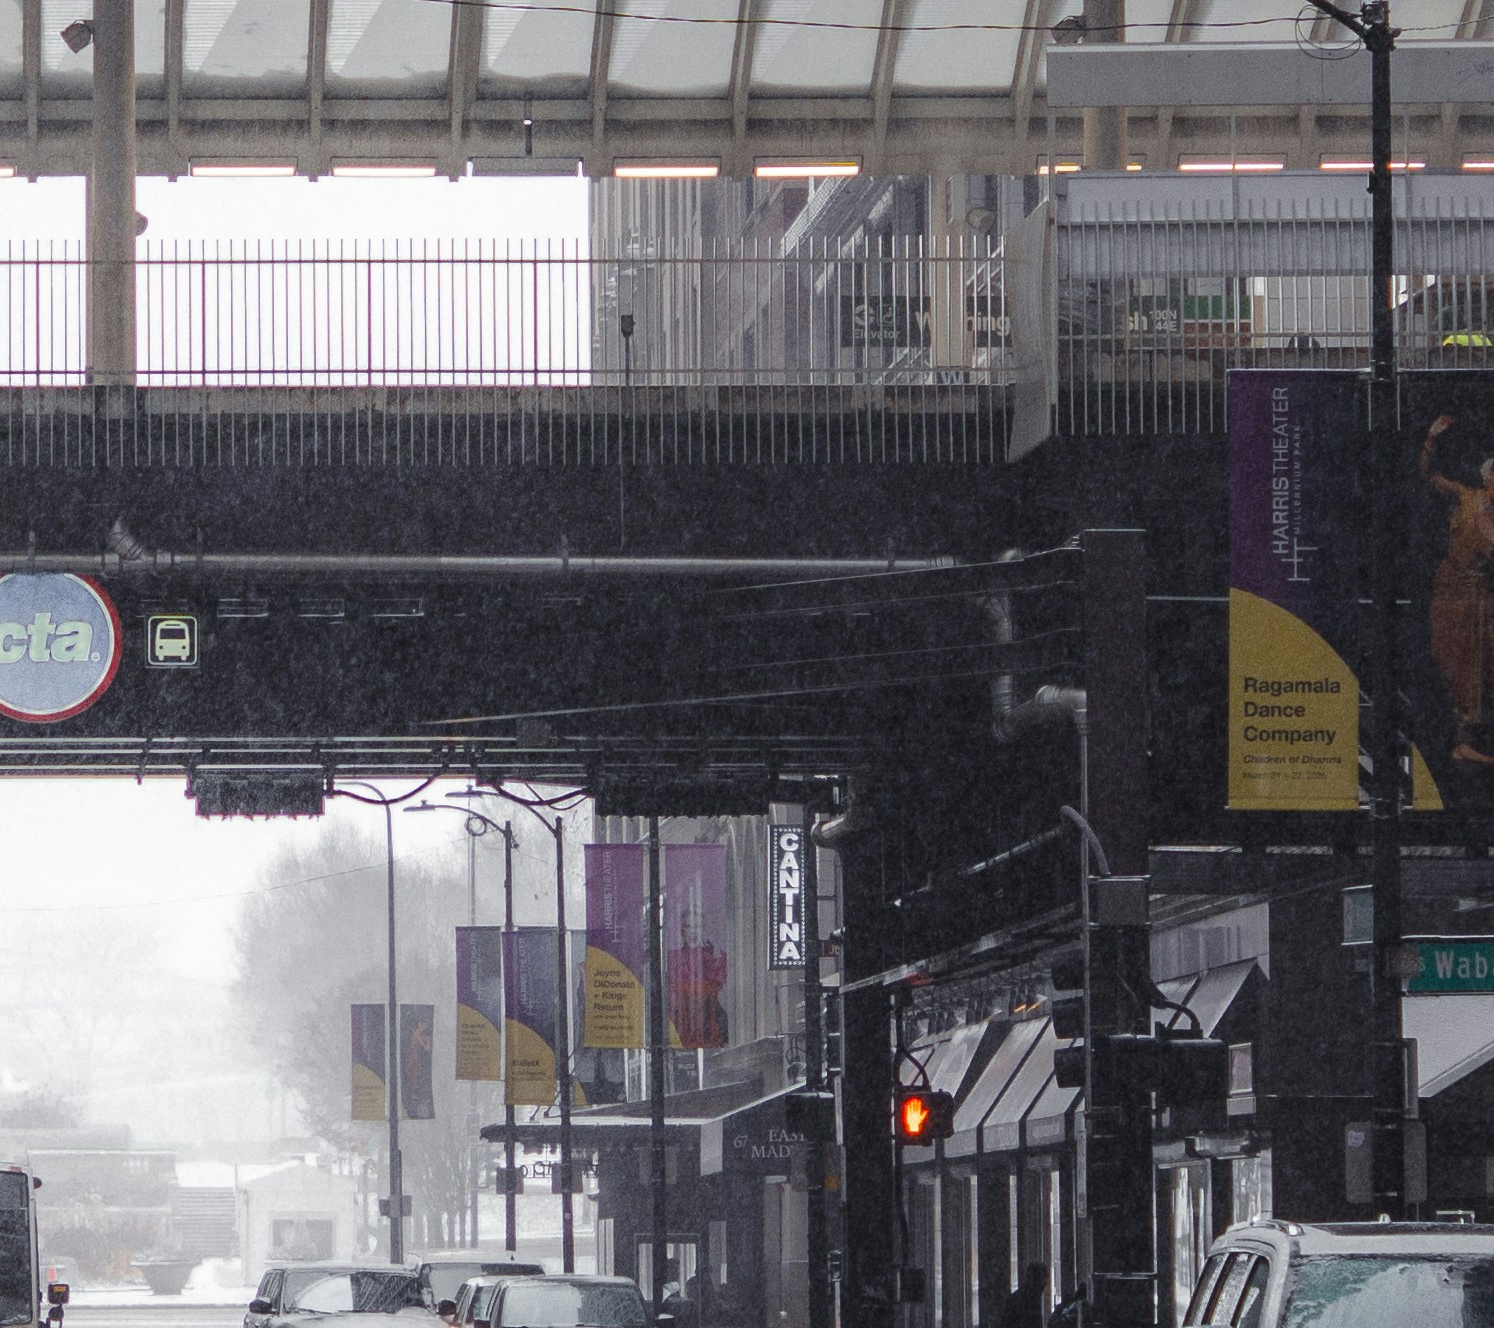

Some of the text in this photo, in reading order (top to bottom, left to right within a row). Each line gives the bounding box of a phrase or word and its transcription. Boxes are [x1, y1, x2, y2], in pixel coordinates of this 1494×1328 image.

[1272, 386, 1290, 555] HARRIS THEATER
[1293, 424, 1303, 535] MILLENNIUM PARK
[1243, 677, 1341, 697] Ragamala
[1243, 701, 1306, 718] Dance
[1243, 725, 1337, 746] Company
[1243, 754, 1286, 764] Children
[1289, 754, 1300, 764] of
[779, 832, 801, 960] CANTINA
[733, 1135, 748, 1148] 67
